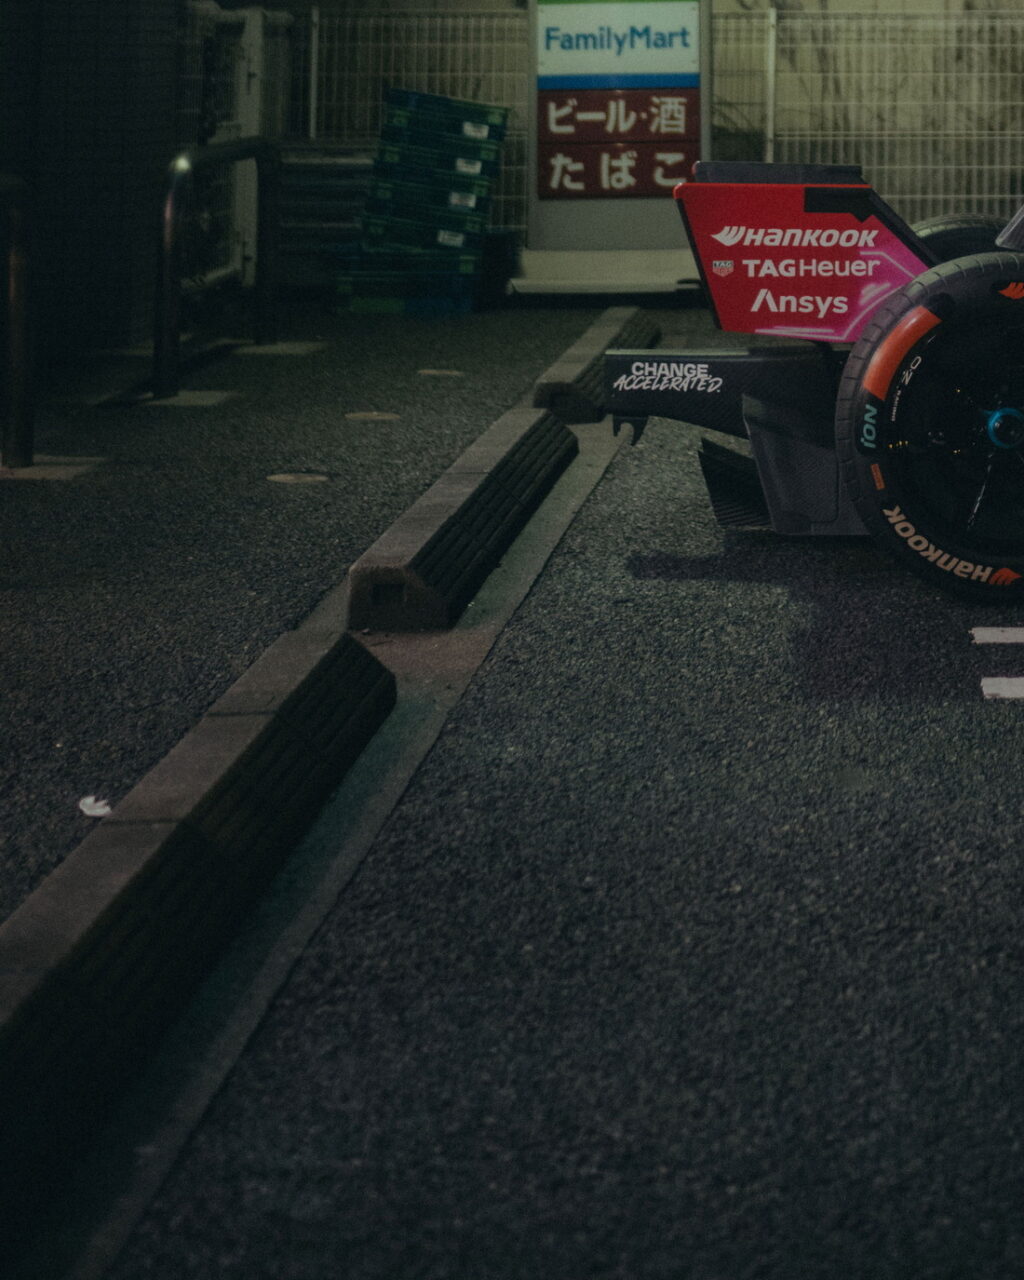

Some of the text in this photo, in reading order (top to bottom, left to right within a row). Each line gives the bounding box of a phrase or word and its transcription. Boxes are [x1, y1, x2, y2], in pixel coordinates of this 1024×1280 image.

[544, 25, 691, 56] FamilyMart
[549, 152, 686, 190] たばこ
[750, 288, 849, 319] Ansys
